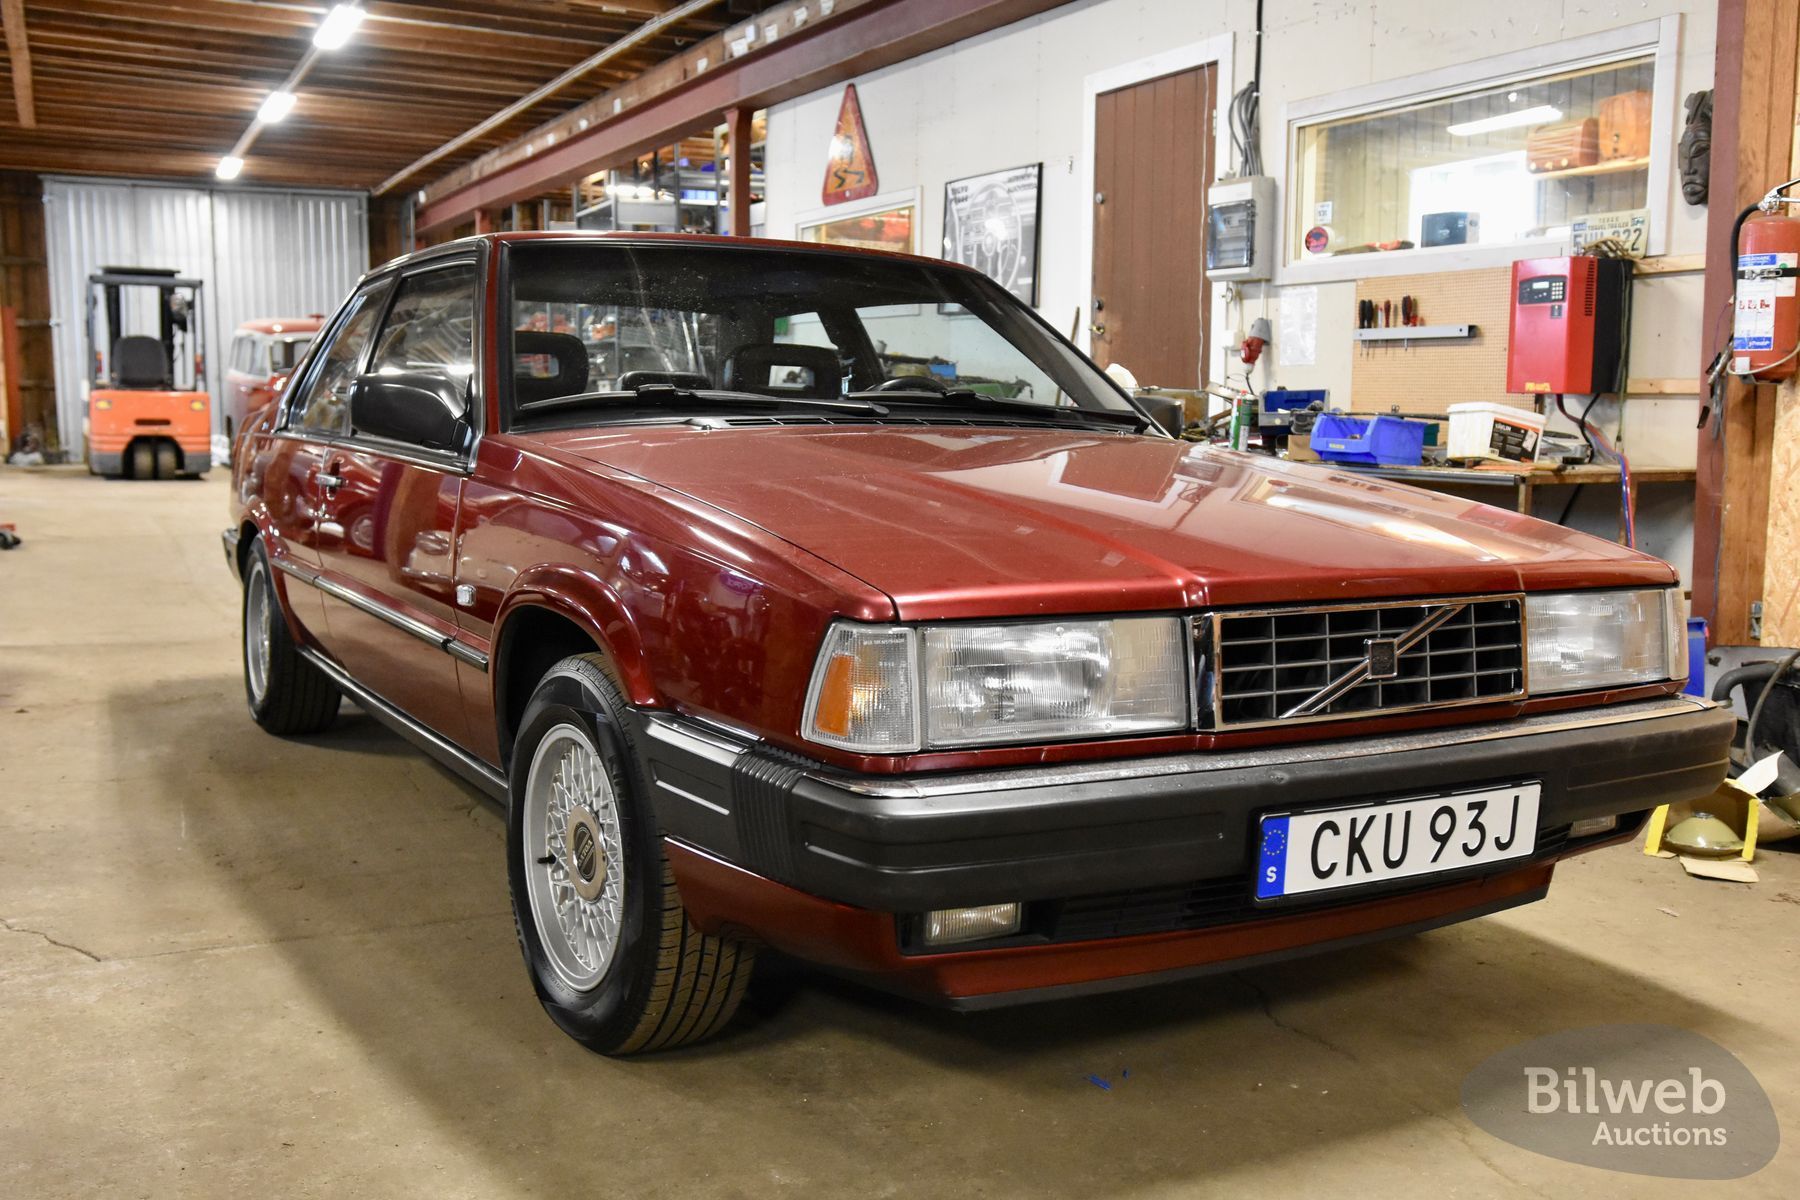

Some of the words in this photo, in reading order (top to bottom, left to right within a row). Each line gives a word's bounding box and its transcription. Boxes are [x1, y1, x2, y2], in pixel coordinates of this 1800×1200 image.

[1311, 810, 1412, 880] CKU
[1429, 795, 1520, 863] 93J
[1266, 866, 1277, 883] S
